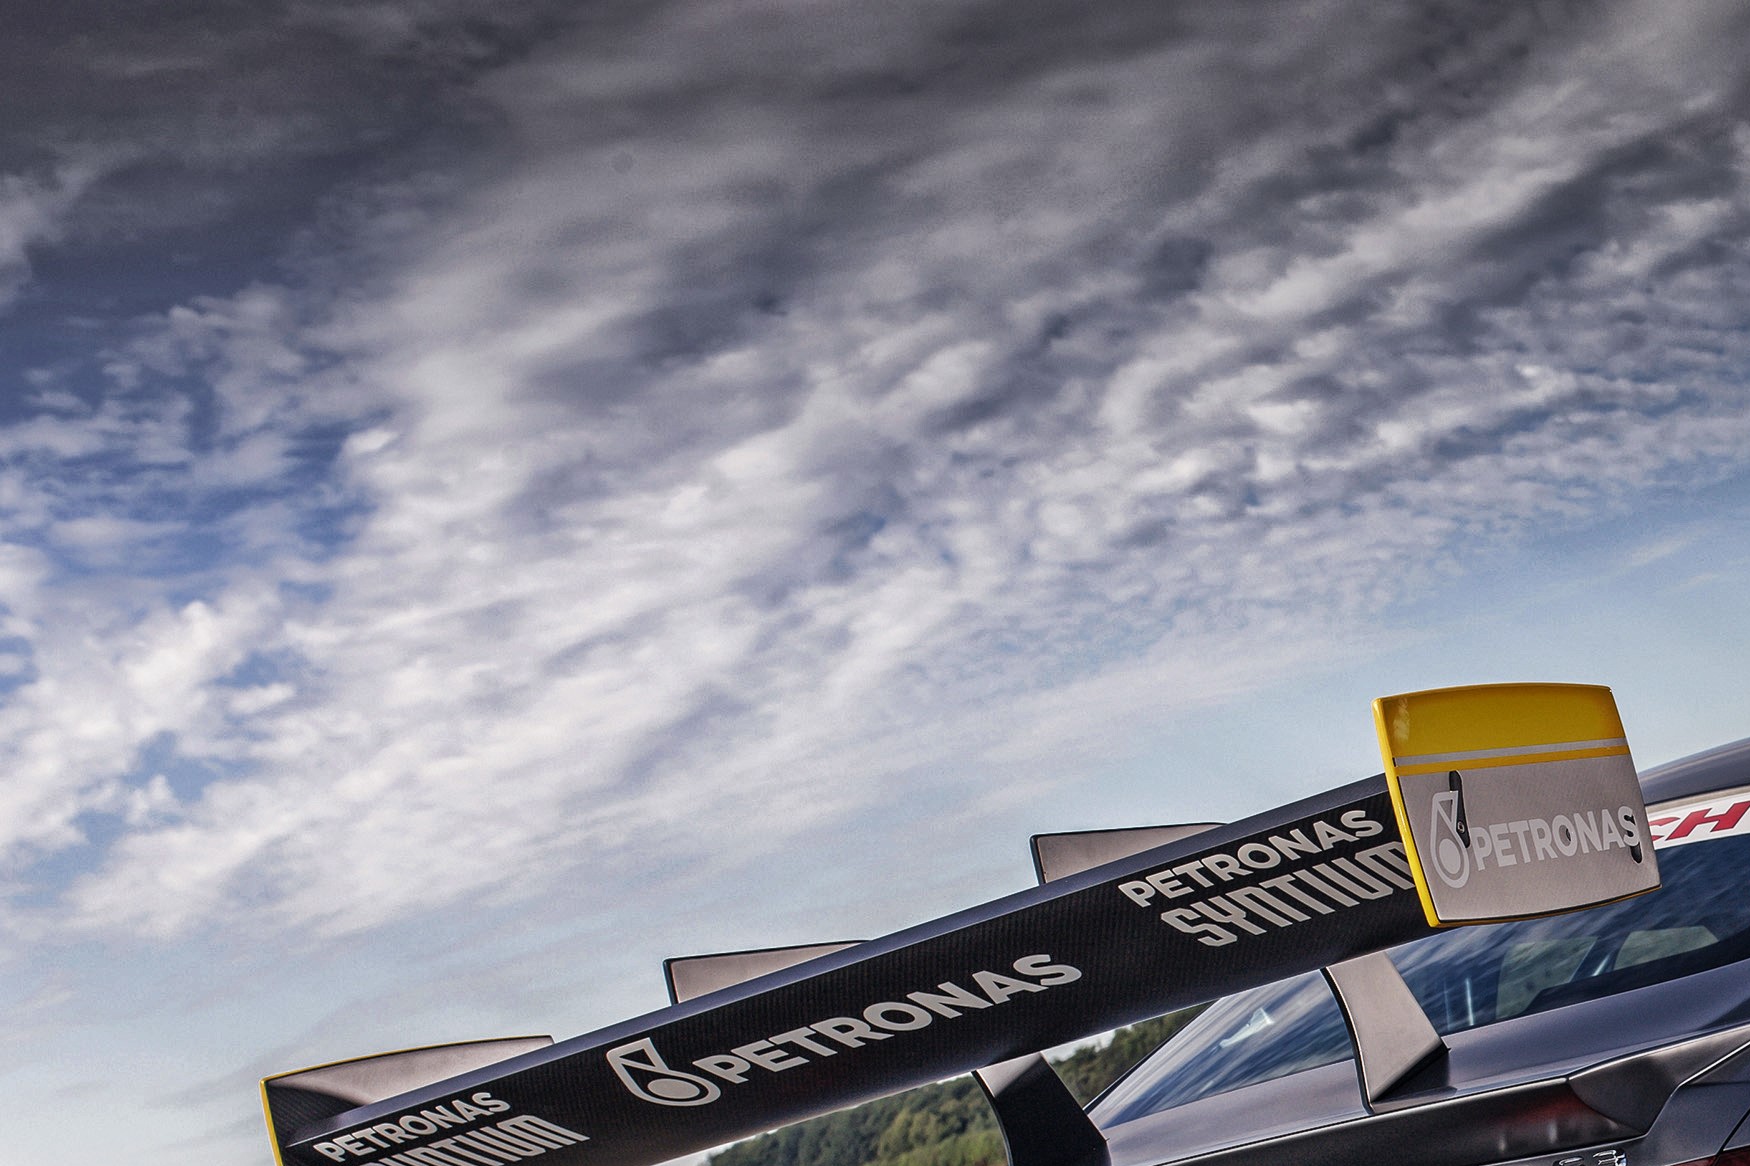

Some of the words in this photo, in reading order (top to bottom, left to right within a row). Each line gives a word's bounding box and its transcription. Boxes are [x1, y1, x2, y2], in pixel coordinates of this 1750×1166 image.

[1117, 810, 1384, 908] PETRONAS
[1469, 806, 1640, 871] PETRONAS
[692, 954, 1083, 1084] PETRONAS
[312, 1092, 511, 1162] PETRONAS
